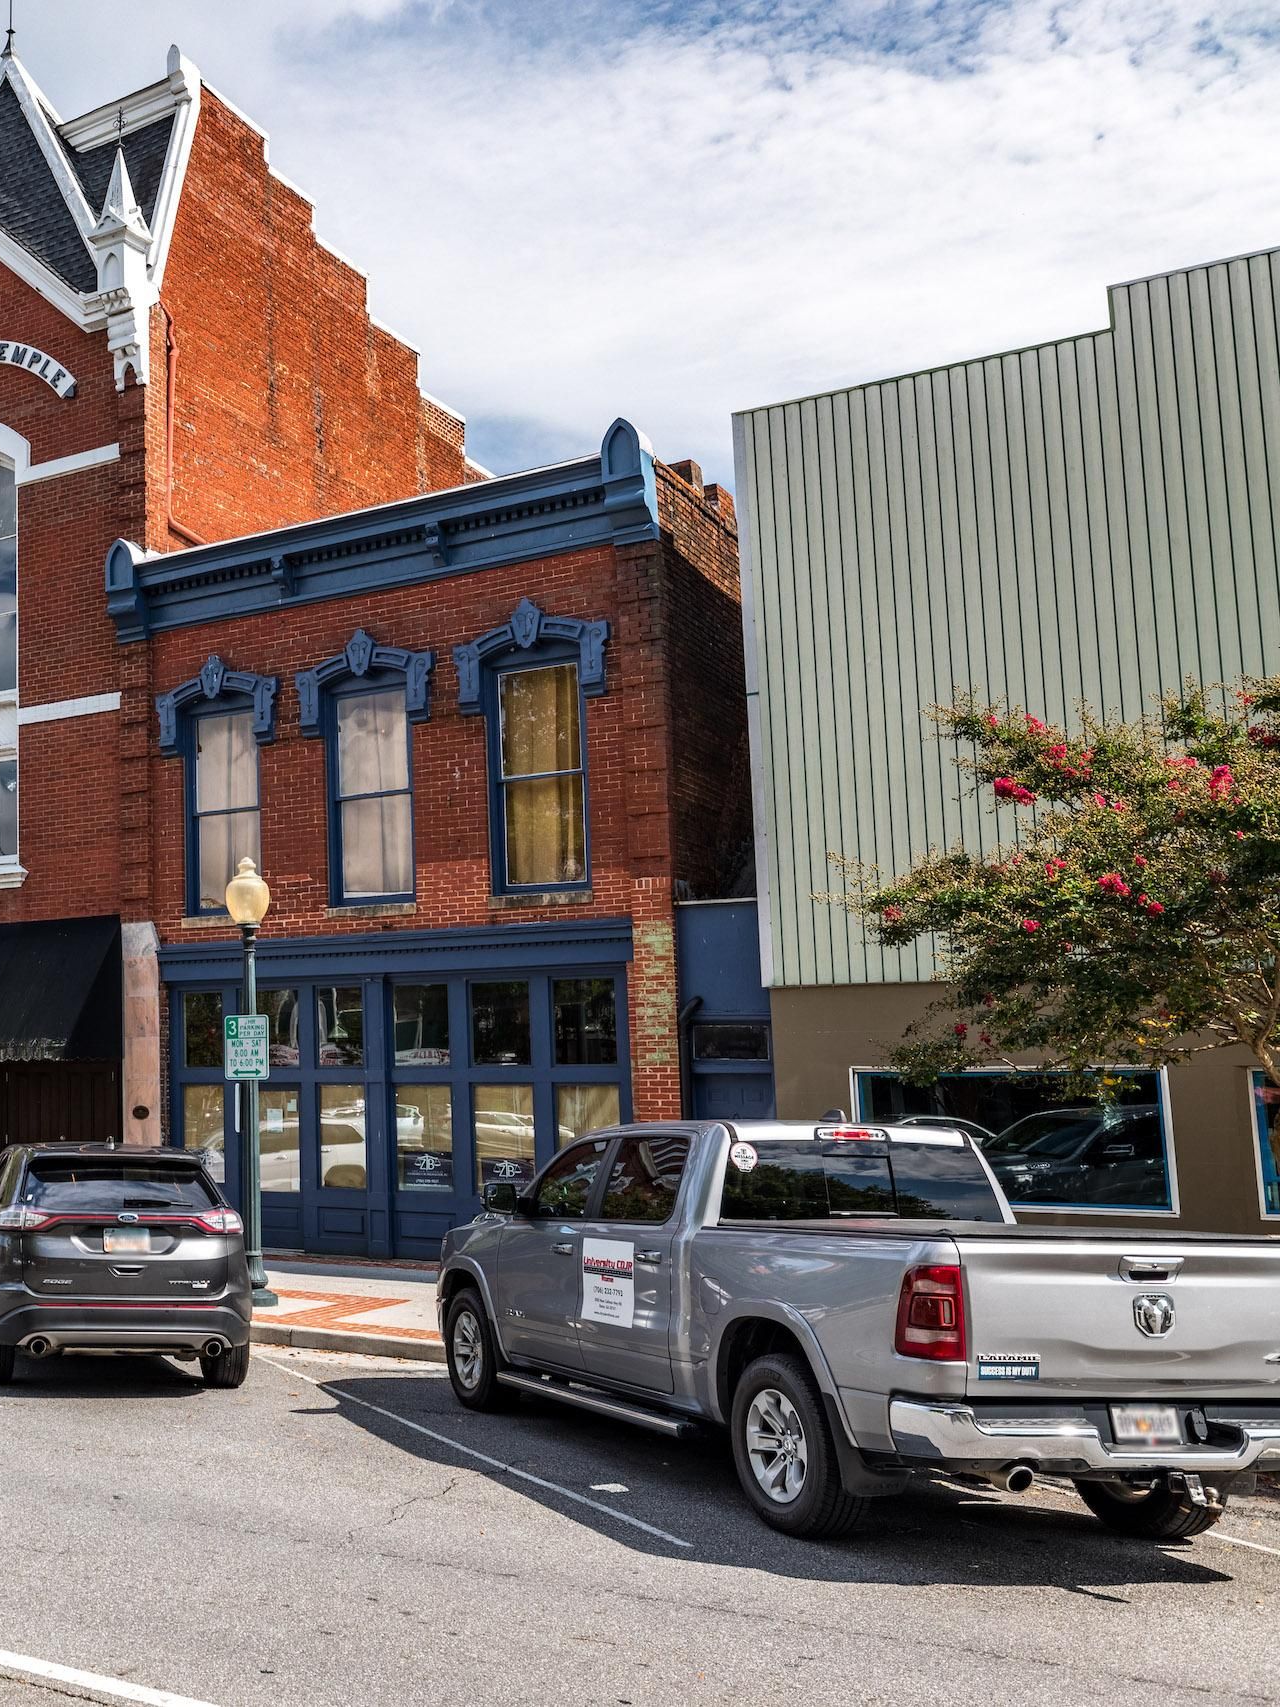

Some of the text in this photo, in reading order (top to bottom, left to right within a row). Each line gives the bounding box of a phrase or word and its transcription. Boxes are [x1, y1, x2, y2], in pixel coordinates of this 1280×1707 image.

[228, 1020, 237, 1036] 3
[231, 1040, 244, 1048] MON
[250, 1049, 259, 1057] AM
[230, 1059, 237, 1067] TO
[583, 1256, 633, 1271] University CDJR
[980, 1366, 1037, 1376] SUCCESS IS MY DUTY
